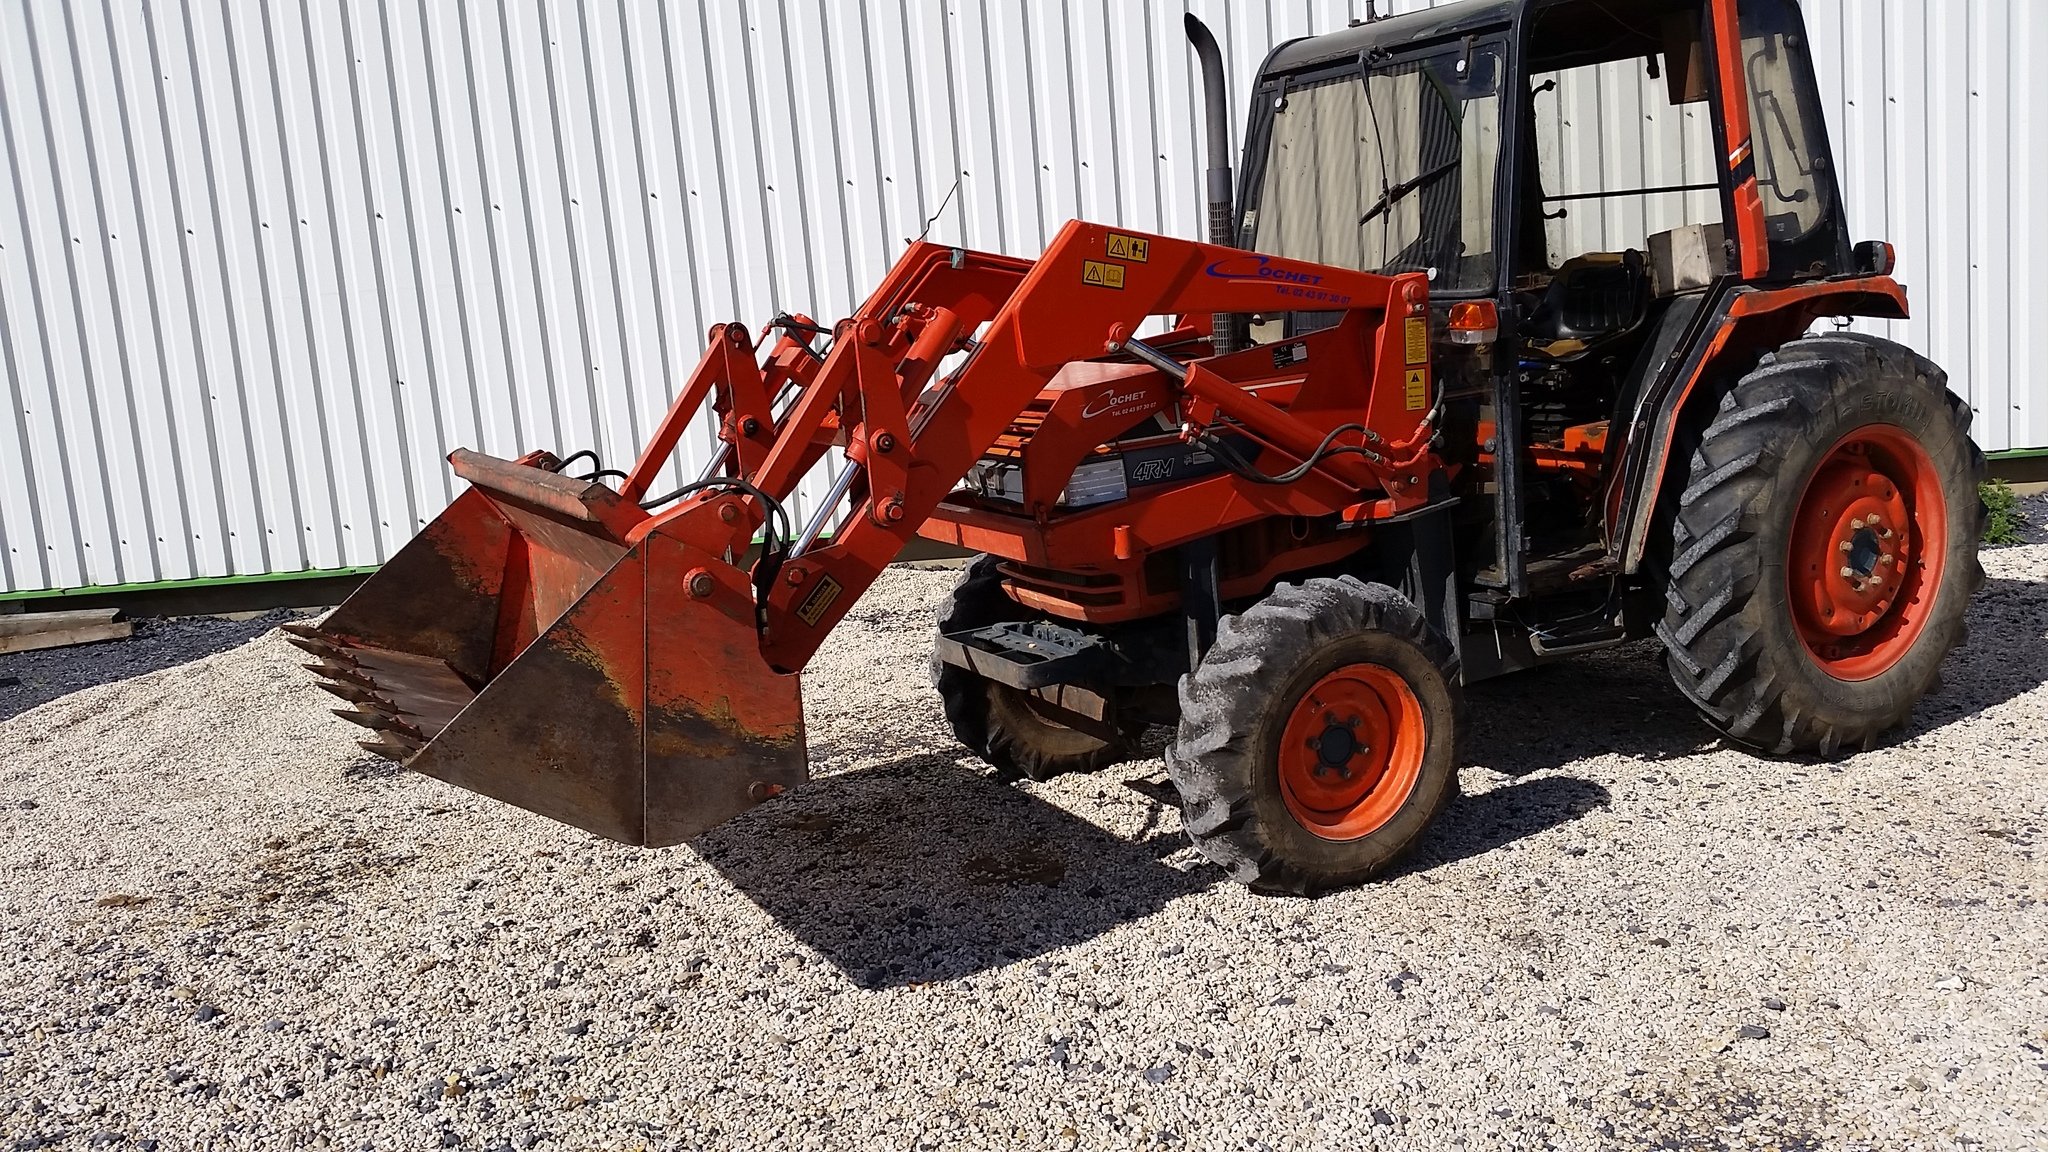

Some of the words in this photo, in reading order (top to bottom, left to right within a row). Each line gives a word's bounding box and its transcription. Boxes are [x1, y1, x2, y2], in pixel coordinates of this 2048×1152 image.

[1206, 255, 1323, 285] COCHET
[1293, 288, 1303, 296] 02
[1082, 389, 1146, 418] COCHET
[1133, 457, 1174, 481] 4RM
